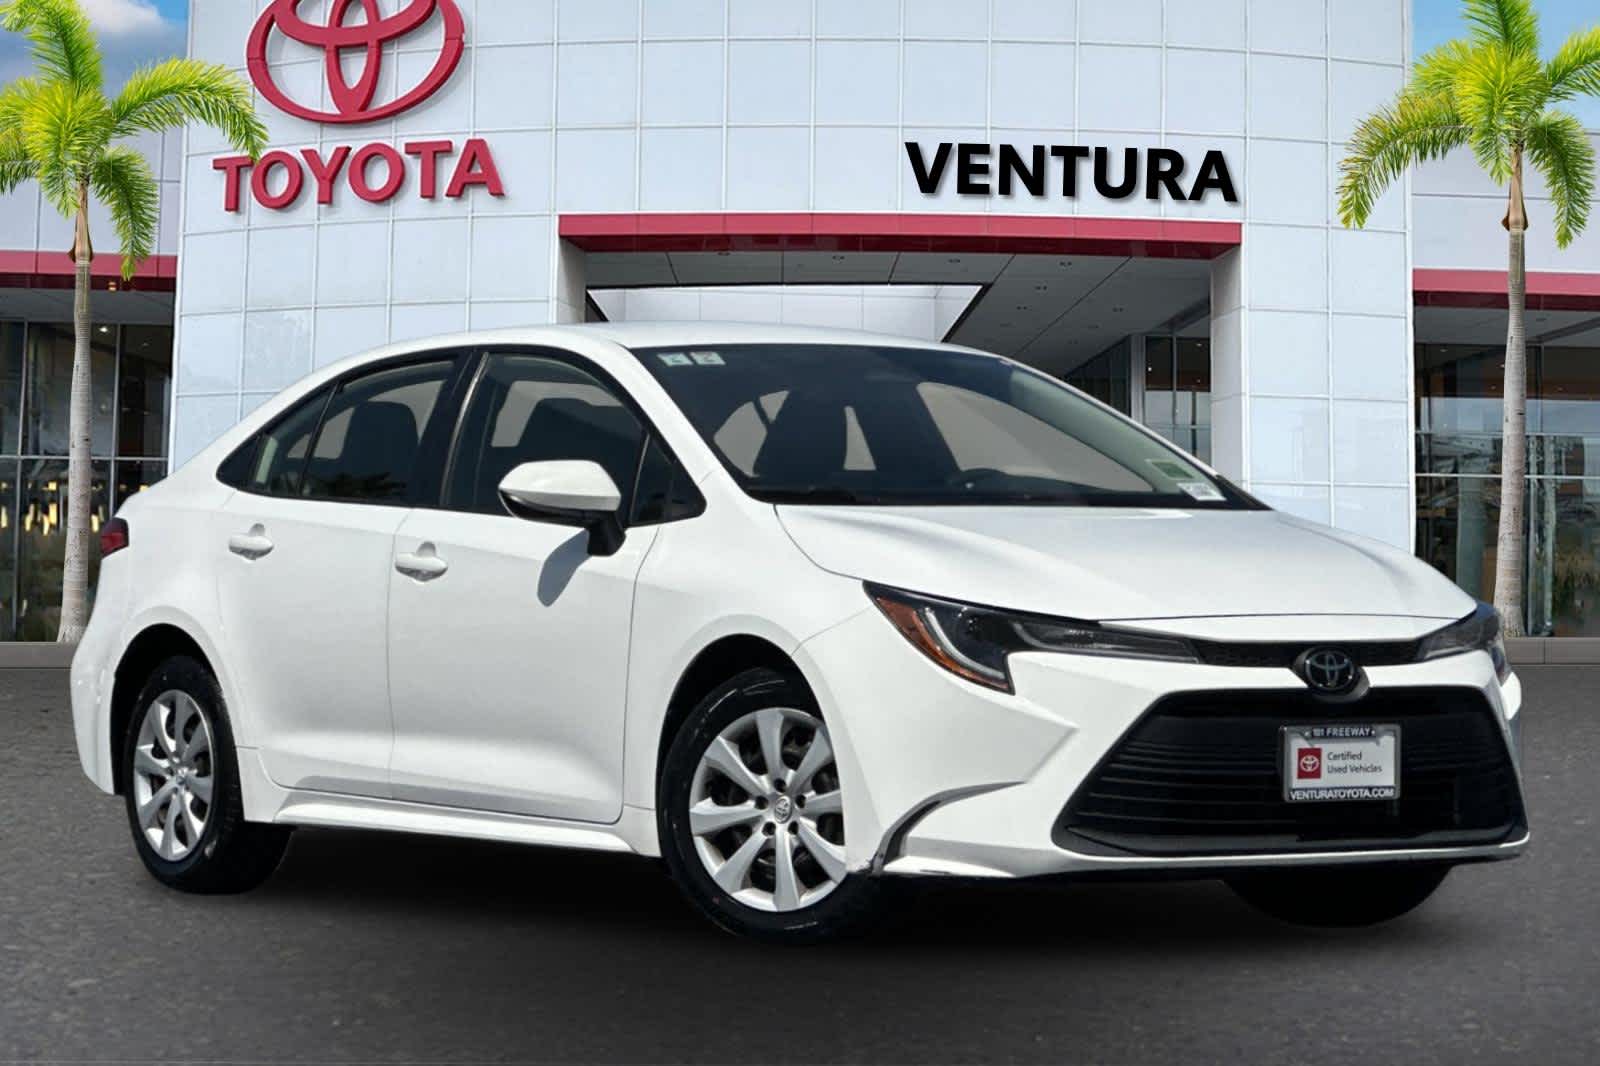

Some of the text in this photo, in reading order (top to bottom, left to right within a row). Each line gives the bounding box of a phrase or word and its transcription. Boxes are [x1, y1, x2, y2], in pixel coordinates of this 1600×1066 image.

[213, 139, 505, 213] TOYOTA
[905, 142, 1238, 203] VENTURA
[1326, 727, 1371, 736] FREEWAY
[1327, 752, 1362, 760] Certified
[1327, 764, 1382, 773] Used Vehicles
[1290, 788, 1395, 800] VENTURATOYOTA.COM
